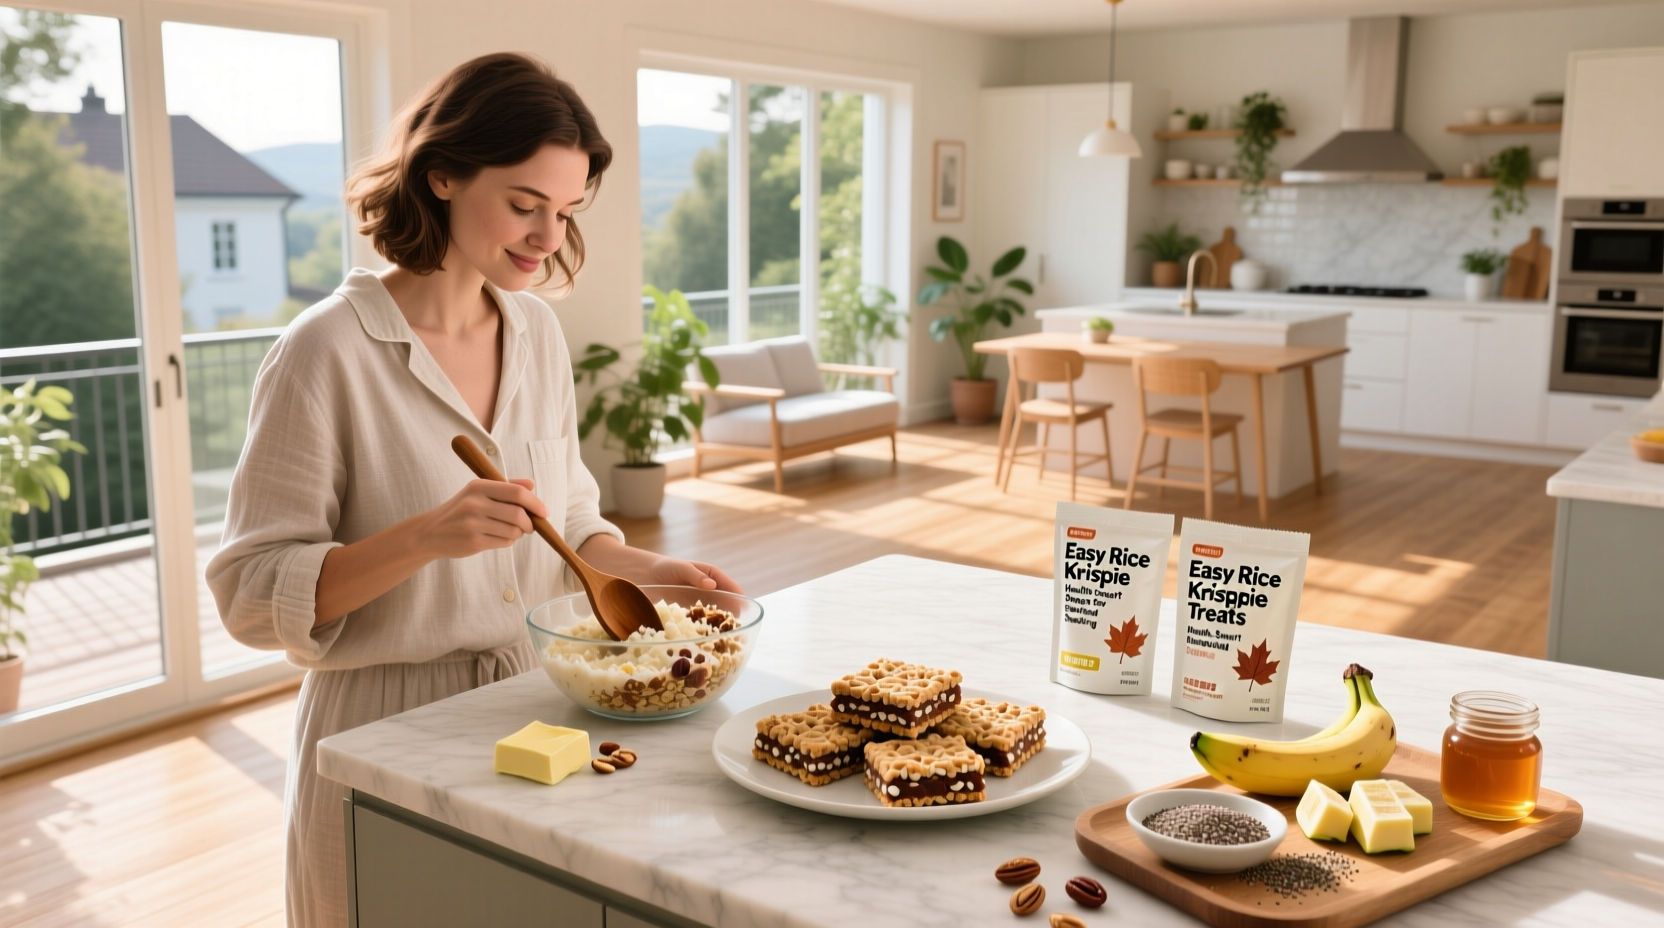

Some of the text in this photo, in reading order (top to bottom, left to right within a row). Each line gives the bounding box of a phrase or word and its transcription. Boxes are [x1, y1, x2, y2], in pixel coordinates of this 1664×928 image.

[1065, 542, 1151, 569] Easy Rice
[1064, 562, 1131, 588] Krispie
[1188, 560, 1282, 588] Easy Rice
[1188, 582, 1269, 608] Krisppie
[1187, 602, 1247, 626] Treats
